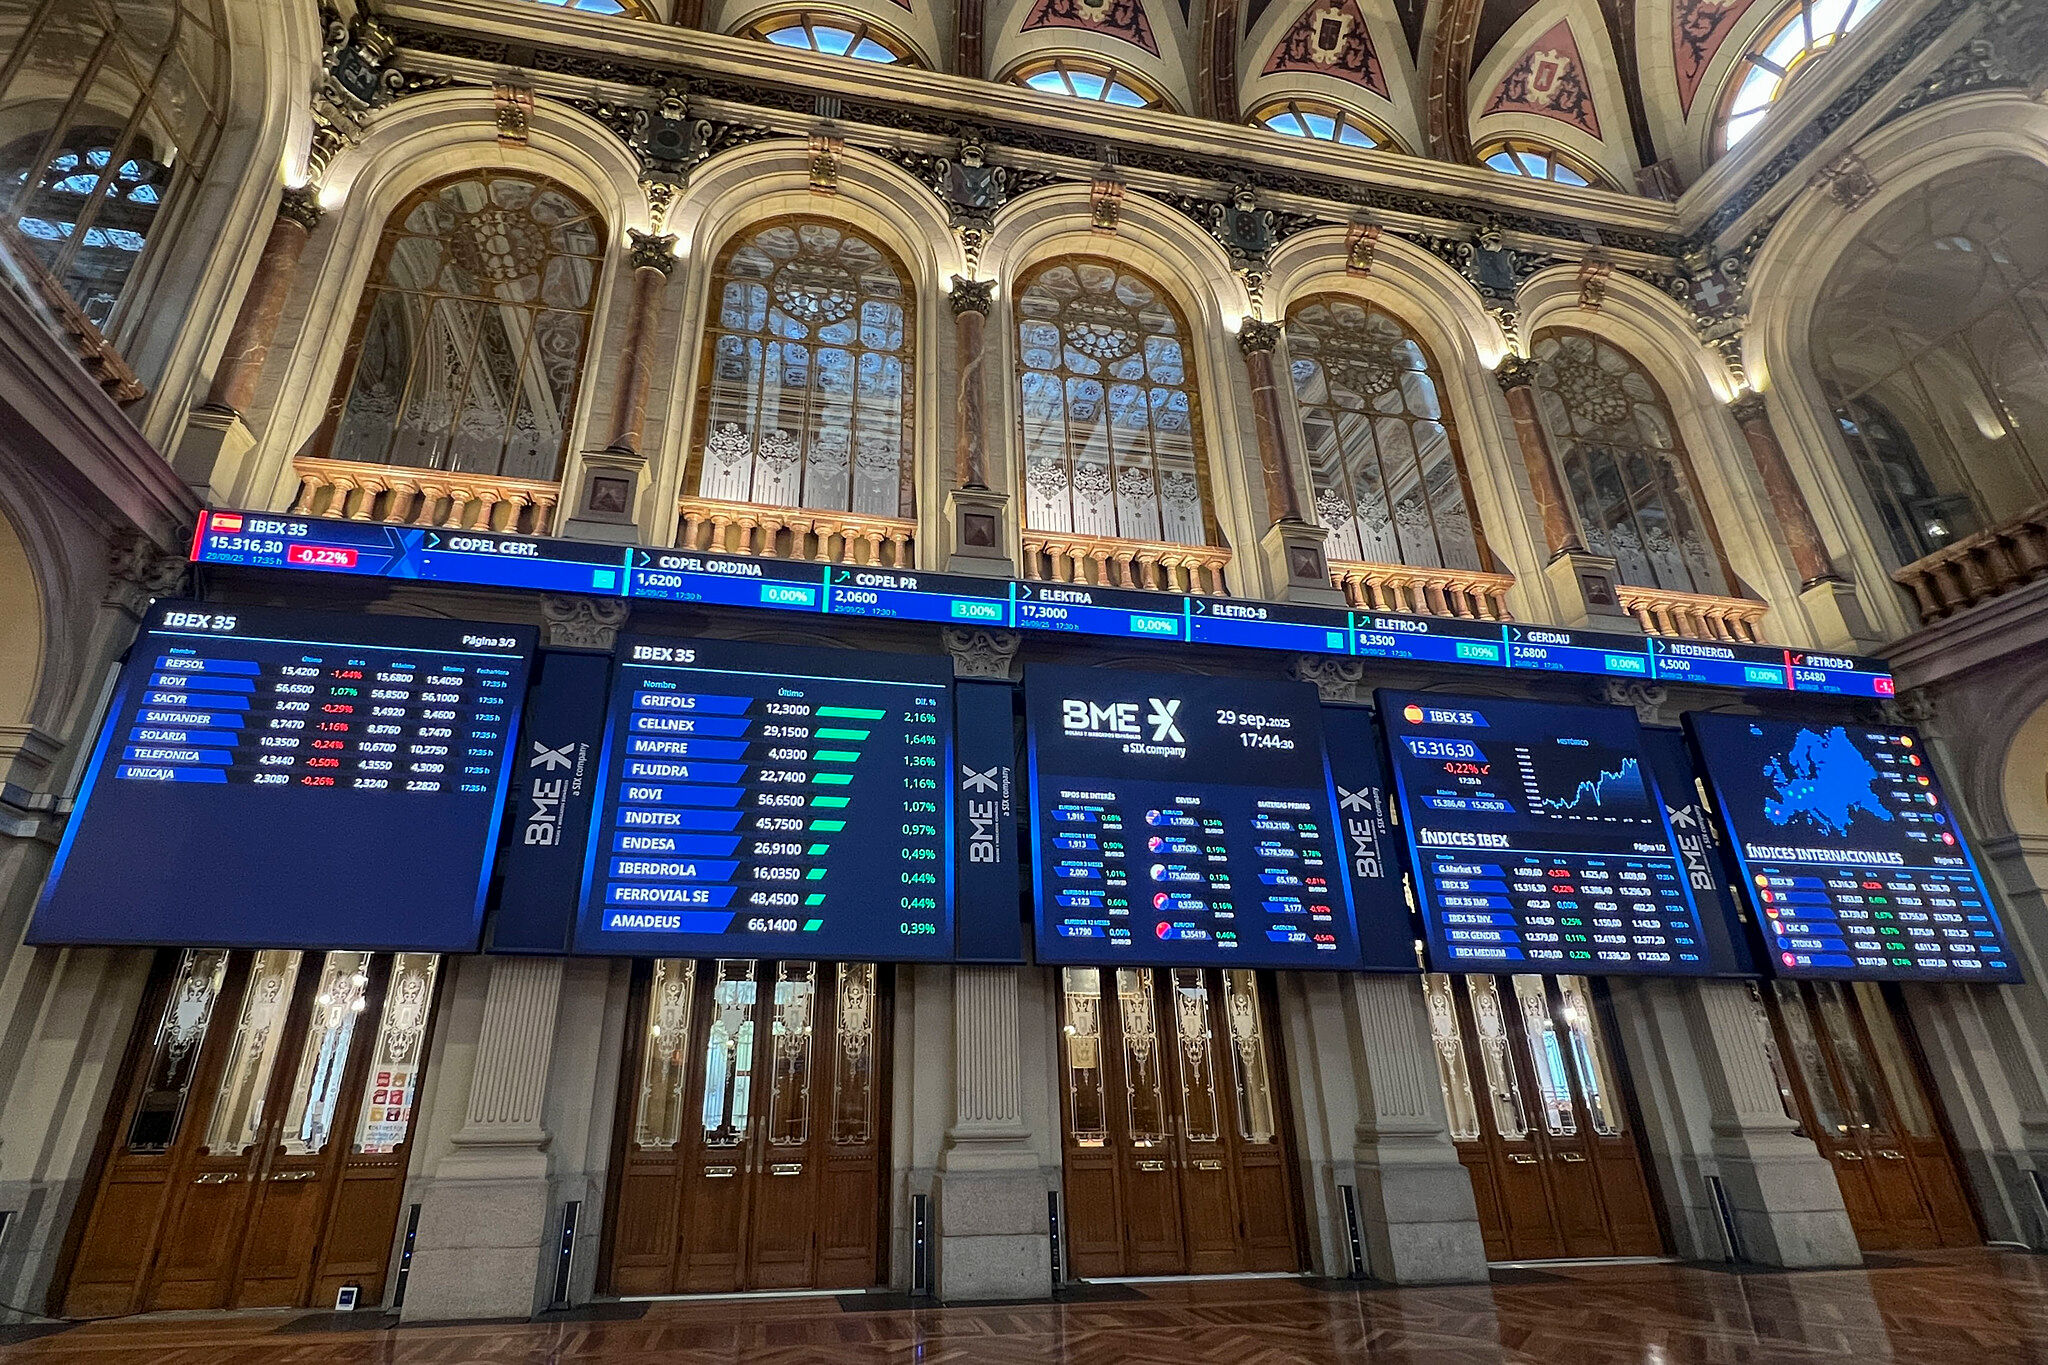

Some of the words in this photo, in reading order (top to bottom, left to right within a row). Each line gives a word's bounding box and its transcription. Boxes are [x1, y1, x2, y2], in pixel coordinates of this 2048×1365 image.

[248, 520, 284, 535] IBEX
[287, 524, 308, 536] 35
[210, 536, 283, 554] 15.316,30
[450, 537, 497, 553] COPEL
[500, 540, 538, 556] CERT.
[297, 550, 348, 564] -0,22%
[659, 555, 703, 570] COPEL
[706, 561, 762, 576] ORDINA
[638, 573, 682, 588] 1,6200
[856, 574, 898, 588] COPEL
[900, 578, 917, 590] PR
[769, 589, 807, 602] 0,00%
[835, 590, 878, 604] 2,0600
[1039, 589, 1092, 604] ELEKTRA
[959, 604, 995, 617] 3,00%
[1022, 605, 1068, 620] 17,3000
[1212, 604, 1267, 620] ELETRO-B
[164, 612, 210, 628] IBEX
[212, 616, 236, 630] 35
[1138, 619, 1171, 632] 0,00%
[1374, 618, 1428, 632] ELETRO-O
[462, 635, 497, 648] Página
[499, 638, 516, 648] 3/3
[1360, 634, 1395, 646] 8,3500
[1528, 632, 1570, 644] GERDAU
[633, 646, 672, 662] IBEX
[674, 650, 696, 662] 35
[1463, 646, 1494, 658] 3,09%
[1514, 646, 1547, 659] 2,6800
[1671, 644, 1734, 659] NEOENERGIA
[1610, 658, 1639, 670] 0,00%
[1659, 659, 1690, 671] 4,5000
[1806, 656, 1854, 670] PETROB-O
[166, 659, 204, 669] REPSOL
[282, 666, 320, 676] 15,4200
[376, 672, 414, 683] 15,6800
[426, 676, 463, 686] 15,4050
[1750, 670, 1776, 681] 0,00%
[1796, 670, 1826, 682] 5,6480
[160, 676, 187, 686] ROVI
[275, 684, 314, 694] 56,6500
[371, 690, 409, 700] 56,8500
[422, 693, 459, 703] 56,1000
[644, 680, 676, 689] Nombre
[778, 688, 804, 698] Último
[153, 694, 187, 704] SACYR
[276, 702, 310, 712] 3,4700
[372, 707, 405, 717] 3,4920
[423, 710, 456, 720] 3,4600
[641, 695, 696, 709] GRIFOLS
[766, 703, 811, 716] 12,3000
[904, 712, 936, 724] 2,16%
[1063, 700, 1141, 732] BME
[147, 712, 210, 724] SANTANDER
[270, 719, 305, 729] 8,7470
[367, 725, 401, 735] 8,8760
[418, 728, 452, 738] 8,7470
[1216, 710, 1236, 724] 29
[1430, 711, 1458, 722] IBEX
[1460, 713, 1474, 724] 35
[638, 718, 695, 731] CELLNEX
[763, 725, 809, 738] 29,1500
[904, 734, 936, 745] 1,64%
[140, 730, 186, 741] SOLARIA
[260, 737, 299, 748] 10,3500
[359, 742, 397, 752] 10,6700
[410, 745, 448, 756] 10,2750
[1122, 744, 1130, 753] a
[1130, 742, 1146, 754] SIX
[1146, 745, 1186, 759] company
[1410, 741, 1474, 758] 15.316,30
[135, 749, 200, 760] TELEFONICA
[260, 756, 294, 766] 4,3440
[358, 760, 392, 770] 4,3550
[410, 763, 444, 773] 4,3090
[576, 742, 590, 777] company
[635, 740, 688, 754] MAPFRE
[768, 748, 808, 761] 4,0300
[904, 756, 936, 767] 1,36%
[632, 763, 689, 777] FLUIDRA
[760, 770, 806, 783] 22,7400
[904, 778, 936, 789] 1,16%
[1443, 762, 1479, 774] -0,22%
[128, 768, 174, 778] UNICAJA
[254, 774, 290, 784] 2,3080
[354, 778, 388, 789] 2,3240
[406, 781, 440, 791] 2,2820
[572, 778, 582, 790] SIX
[1002, 766, 1010, 799] company
[629, 788, 663, 800] ROVI
[758, 794, 805, 807] 56,6500
[903, 801, 936, 813] 1,07%
[524, 778, 562, 845] BME
[625, 811, 681, 825] INDITEX
[756, 818, 803, 831] 45,7500
[902, 824, 936, 836] 0,97%
[968, 800, 994, 862] BME
[1420, 828, 1476, 846] ÍNDICES
[1476, 834, 1510, 848] IBEX
[622, 836, 675, 850] ENDESA
[754, 842, 802, 856] 26,9100
[902, 849, 936, 860] 0,49%
[1348, 818, 1379, 878] BME
[1746, 843, 1796, 860] ÍNDICES
[1796, 848, 1904, 865] INTERNACIONALES
[1678, 834, 1712, 890] BME
[618, 861, 697, 876] IBERDROLA
[753, 867, 800, 881] 16,0350
[902, 872, 936, 884] 0,44%
[615, 888, 690, 902] FERROVIAL
[692, 891, 710, 902] SE
[750, 892, 799, 906] 48,4500
[901, 898, 936, 909] 0,44%
[611, 914, 681, 928] AMADEUS
[748, 918, 797, 932] 66,1400
[900, 923, 936, 935] 0,39%
